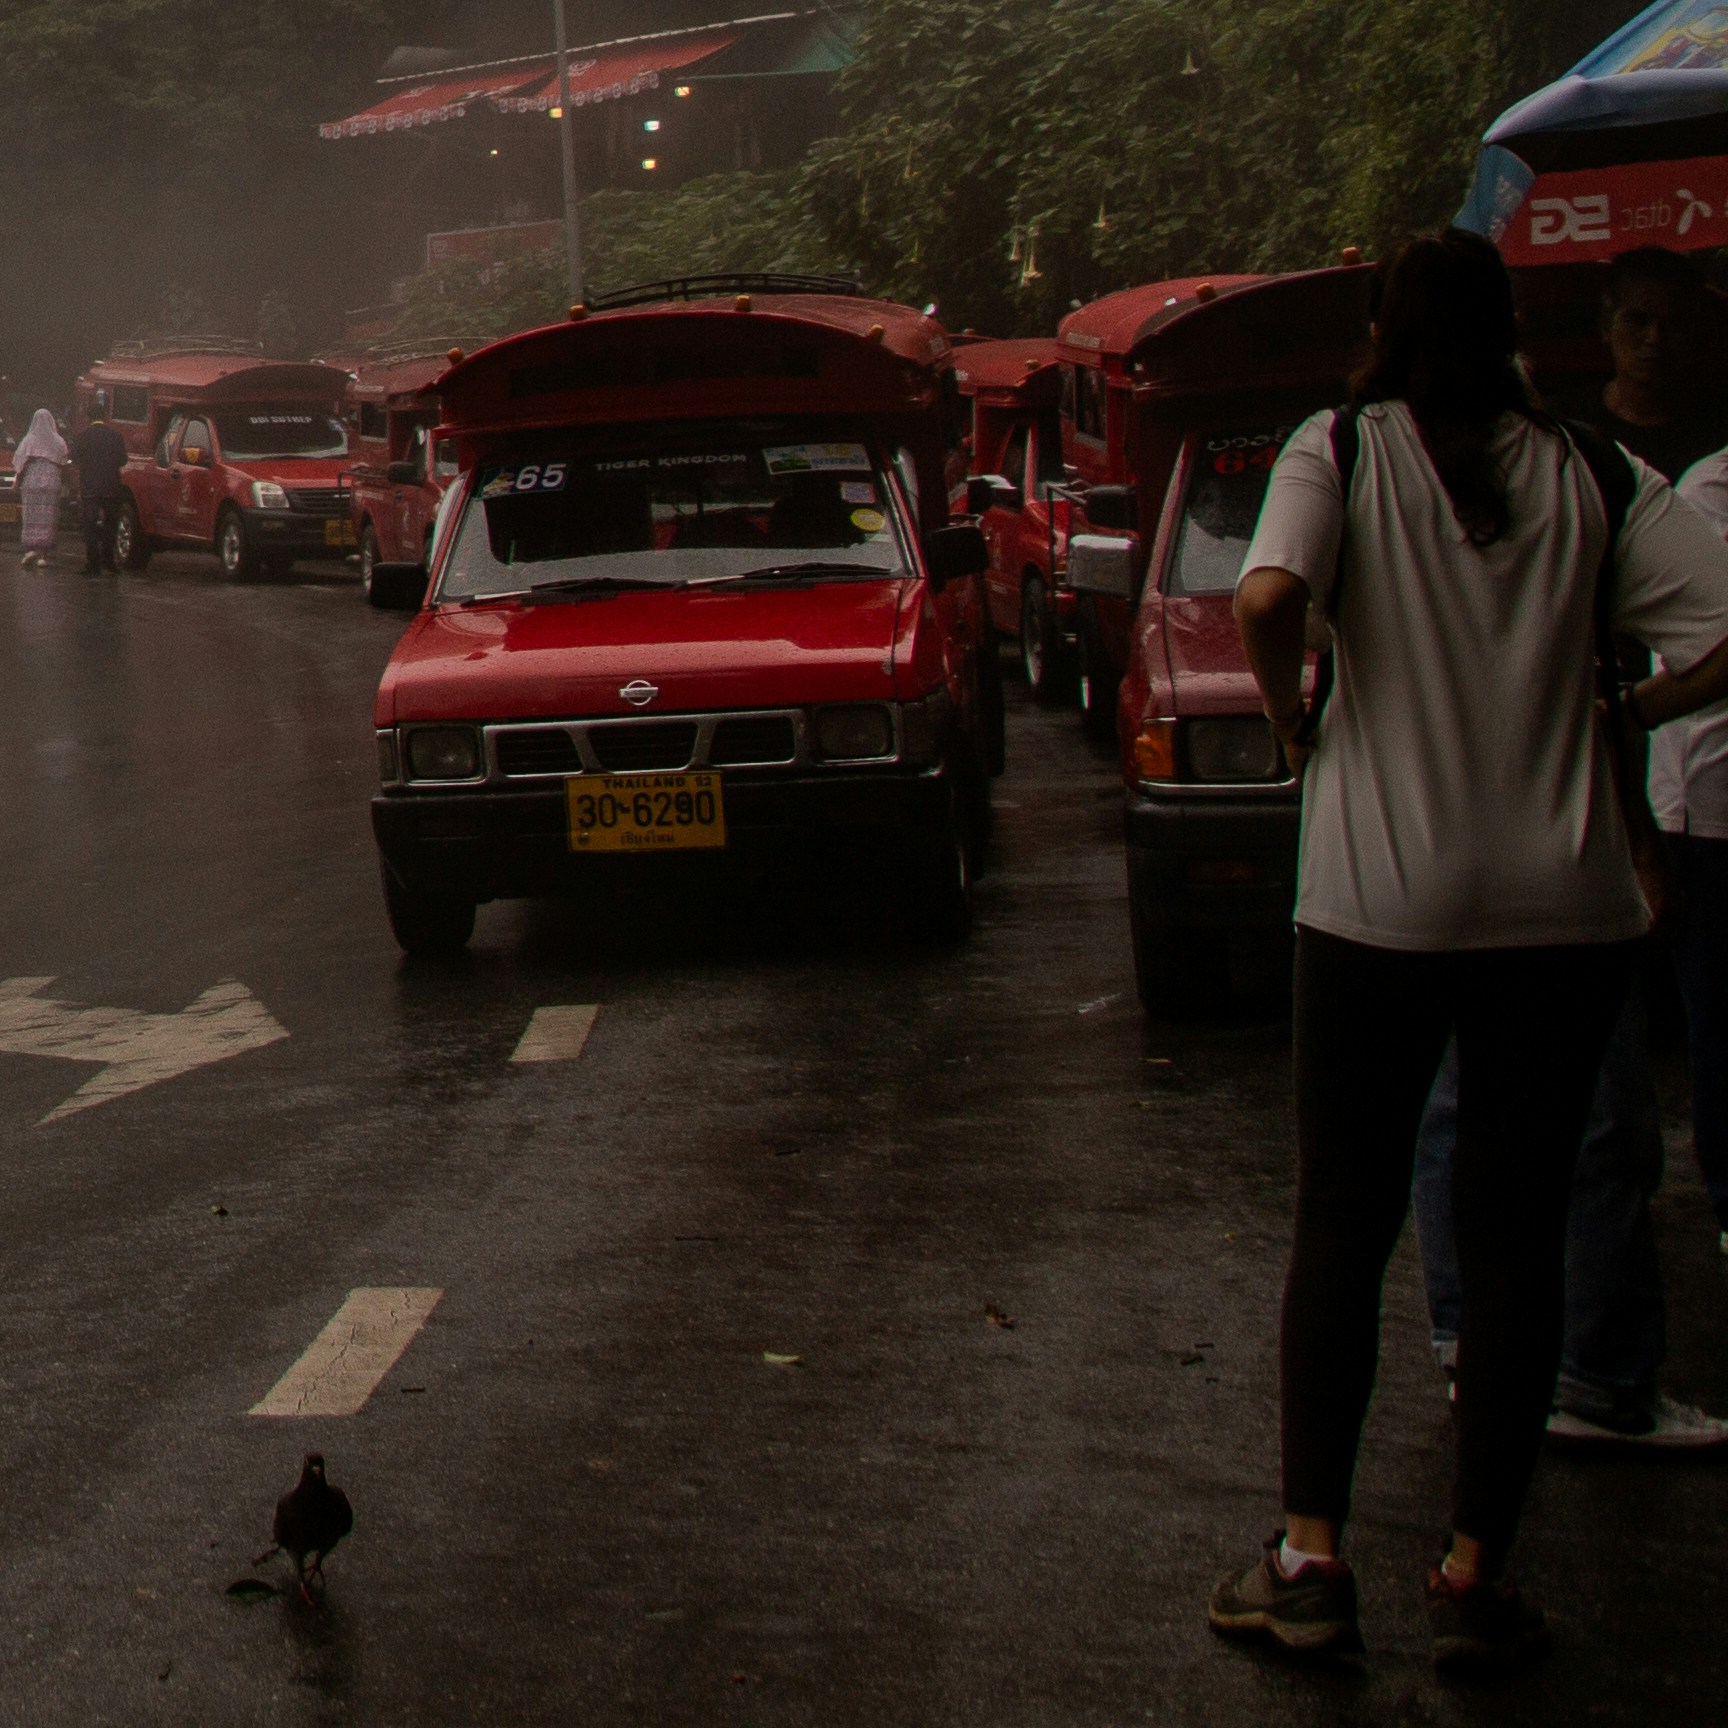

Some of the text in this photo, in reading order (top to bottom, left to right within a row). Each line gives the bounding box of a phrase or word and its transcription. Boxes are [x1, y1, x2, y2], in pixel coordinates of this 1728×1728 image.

[594, 454, 747, 471] TIGER KINGDOM
[515, 463, 567, 490] 65
[602, 776, 686, 788] THAILAND
[577, 790, 715, 828] 30-6290
